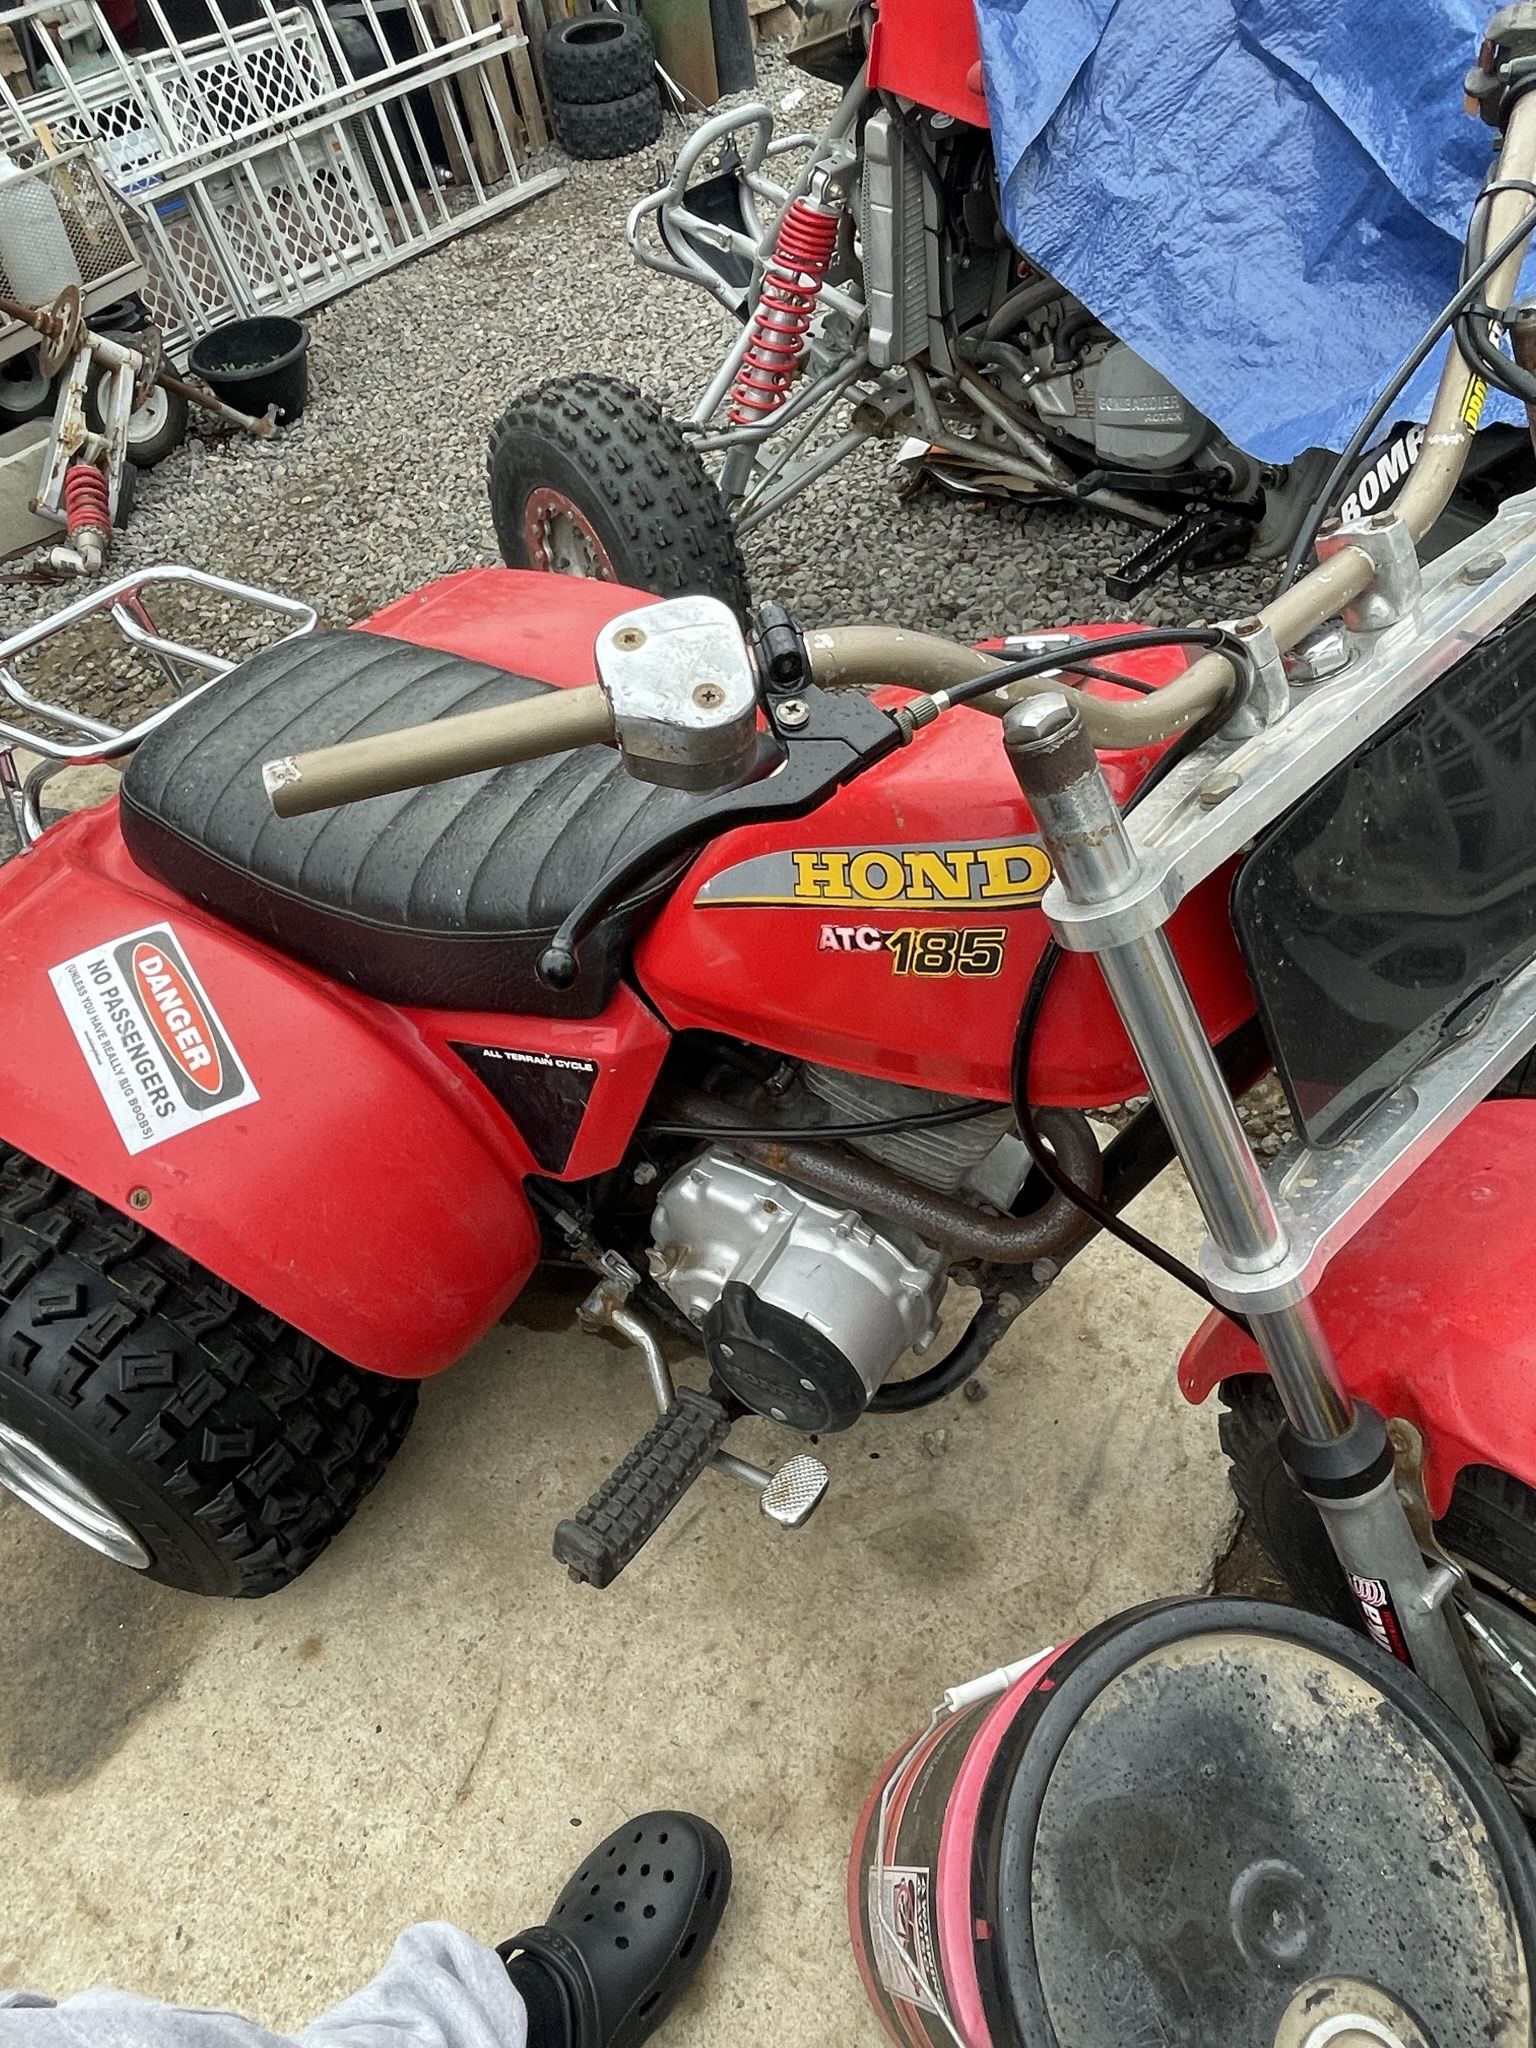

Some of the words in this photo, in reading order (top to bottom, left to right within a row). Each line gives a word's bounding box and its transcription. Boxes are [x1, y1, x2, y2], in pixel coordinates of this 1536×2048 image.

[792, 845, 1051, 900] HOND
[818, 925, 882, 951] ATC
[885, 927, 1008, 977] 185
[65, 964, 88, 998] (UNLESS
[81, 997, 97, 1015] YOU
[138, 955, 211, 1071] DANGER
[86, 1015, 105, 1041] HAVE
[87, 959, 112, 985] NO
[103, 986, 176, 1118] PASSENGERS
[101, 1038, 124, 1077] REALLY
[483, 1049, 503, 1058] ALL
[504, 1052, 553, 1067] TERRAIN
[555, 1060, 593, 1072] CYCLE
[118, 1077, 133, 1098] BIG
[129, 1099, 155, 1140] BOOBS)
